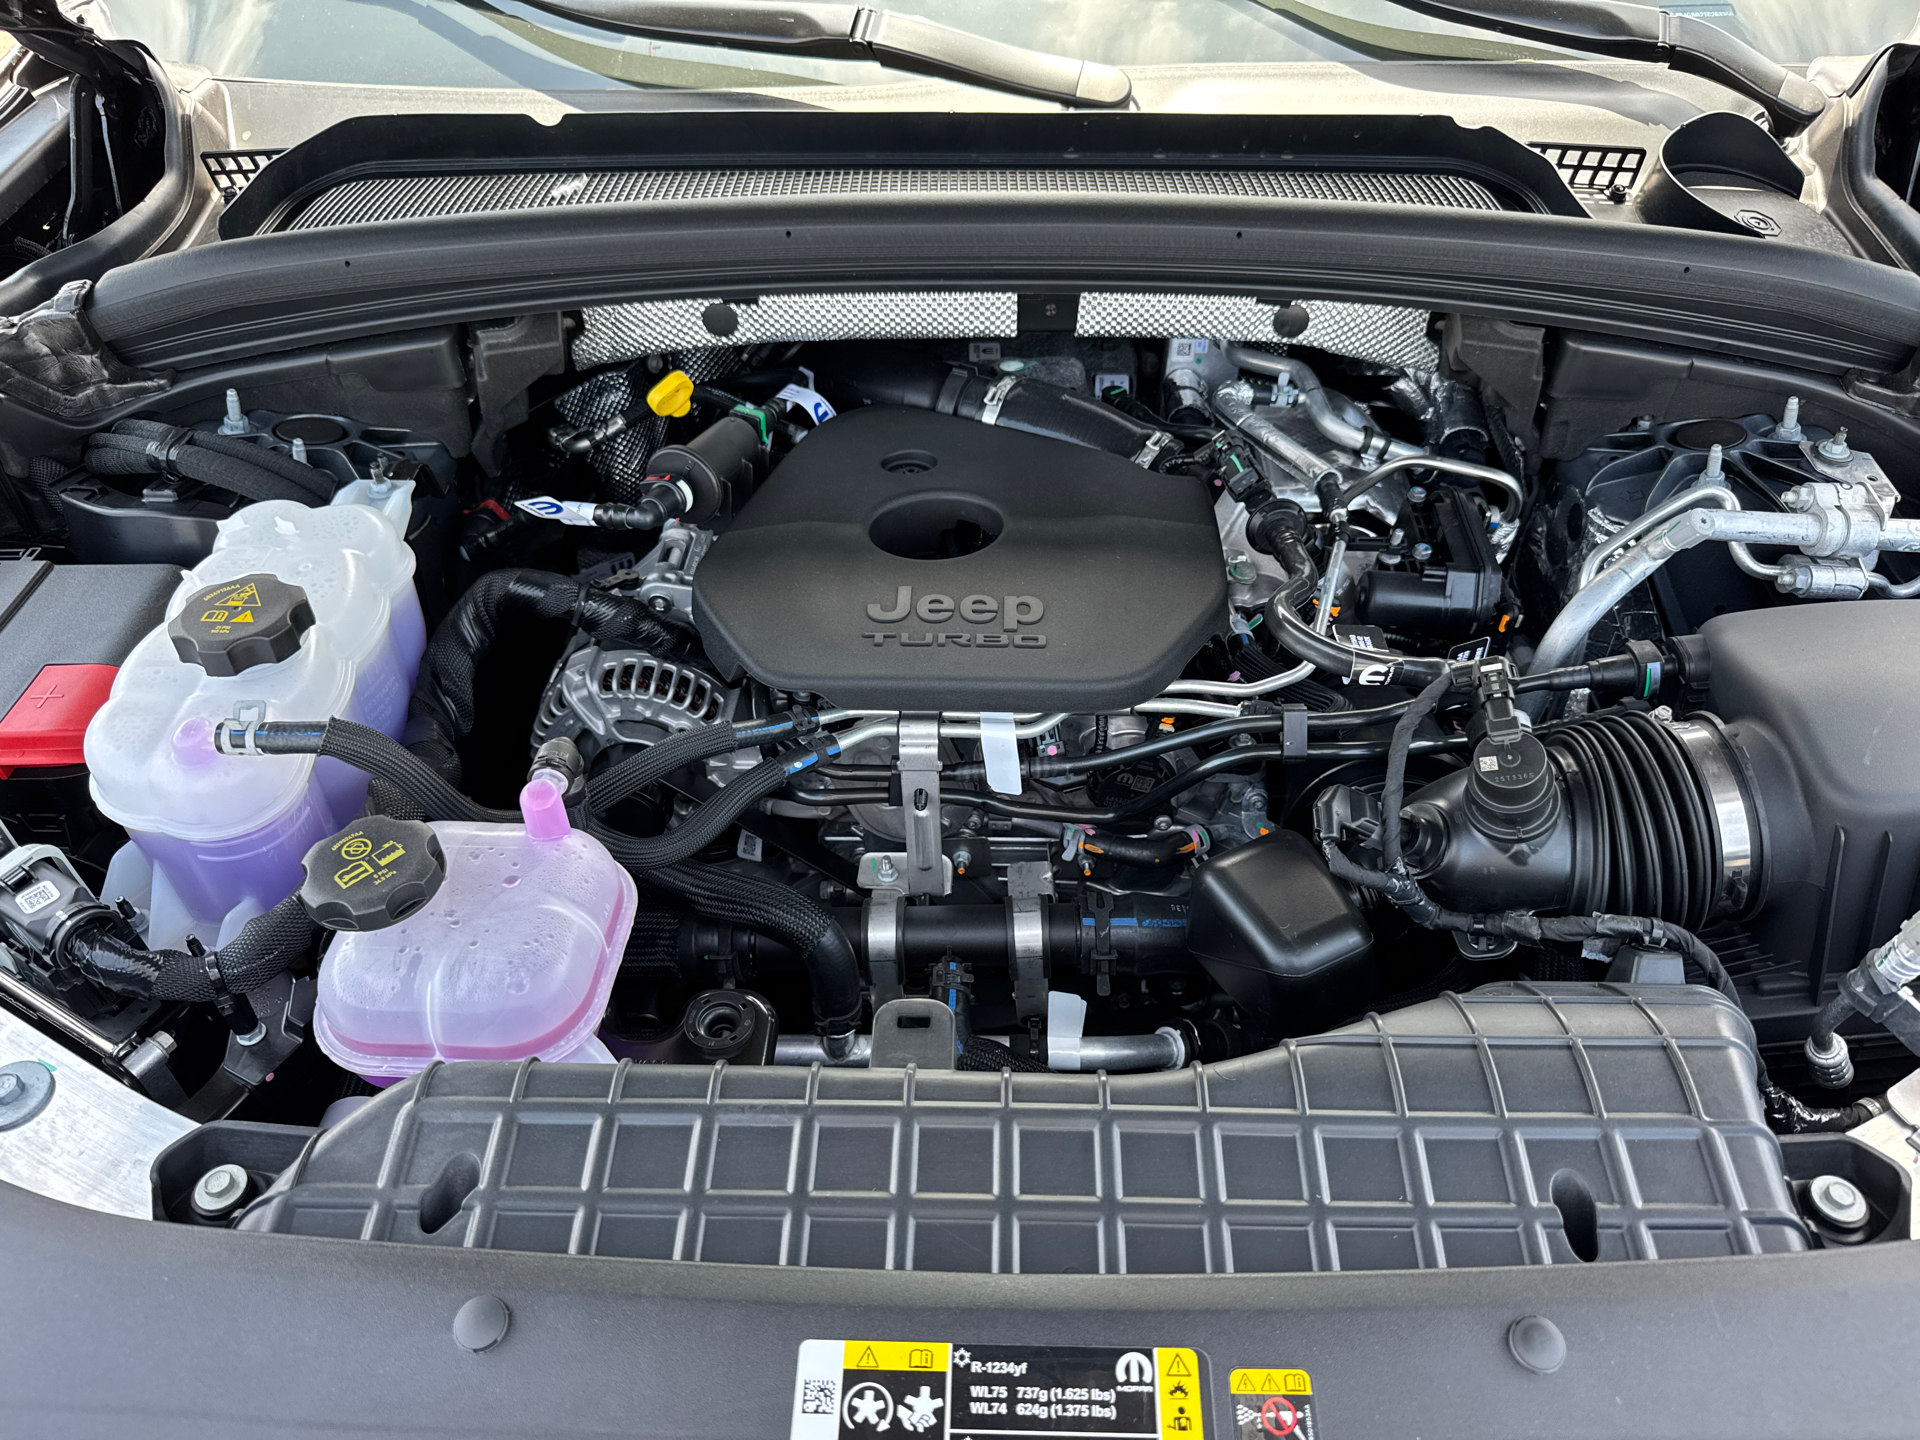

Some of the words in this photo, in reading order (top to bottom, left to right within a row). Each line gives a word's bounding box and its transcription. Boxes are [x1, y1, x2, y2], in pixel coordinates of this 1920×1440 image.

[866, 586, 1045, 632] Jeep
[861, 632, 1048, 649] TURBO
[970, 1361, 1028, 1377] R-1234yf
[969, 1385, 1008, 1398] WL75
[1016, 1386, 1049, 1402] 737g
[1050, 1387, 1090, 1402] (1.625
[1090, 1388, 1117, 1404] lbs)
[1116, 1385, 1154, 1393] MOPAR
[969, 1402, 1008, 1415] WL74
[1015, 1403, 1049, 1419] 624g
[1050, 1403, 1090, 1419] (1.375
[1091, 1404, 1118, 1421] lbs)
